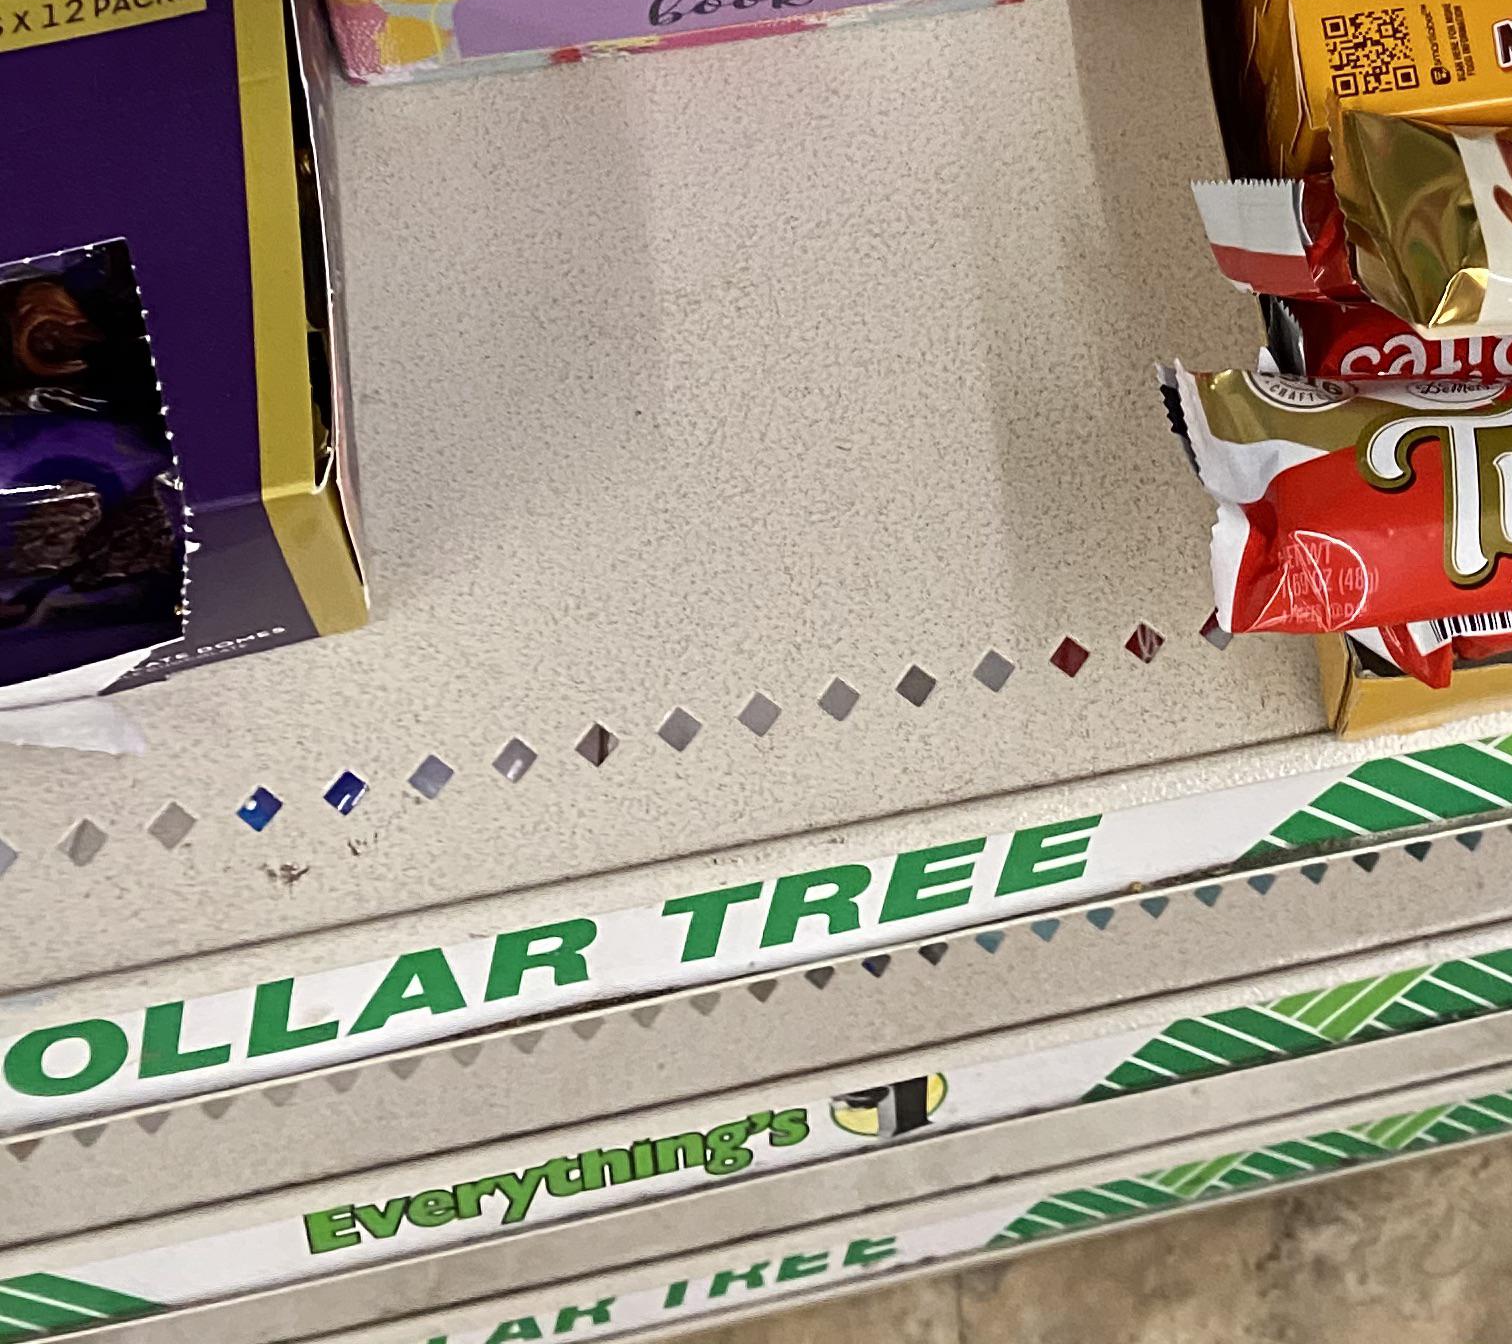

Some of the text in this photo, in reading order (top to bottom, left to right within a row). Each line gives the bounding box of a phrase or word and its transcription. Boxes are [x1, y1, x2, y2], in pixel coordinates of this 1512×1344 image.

[3, 814, 1102, 1097] OLLAR TREE
[303, 1107, 810, 1255] Everything's
